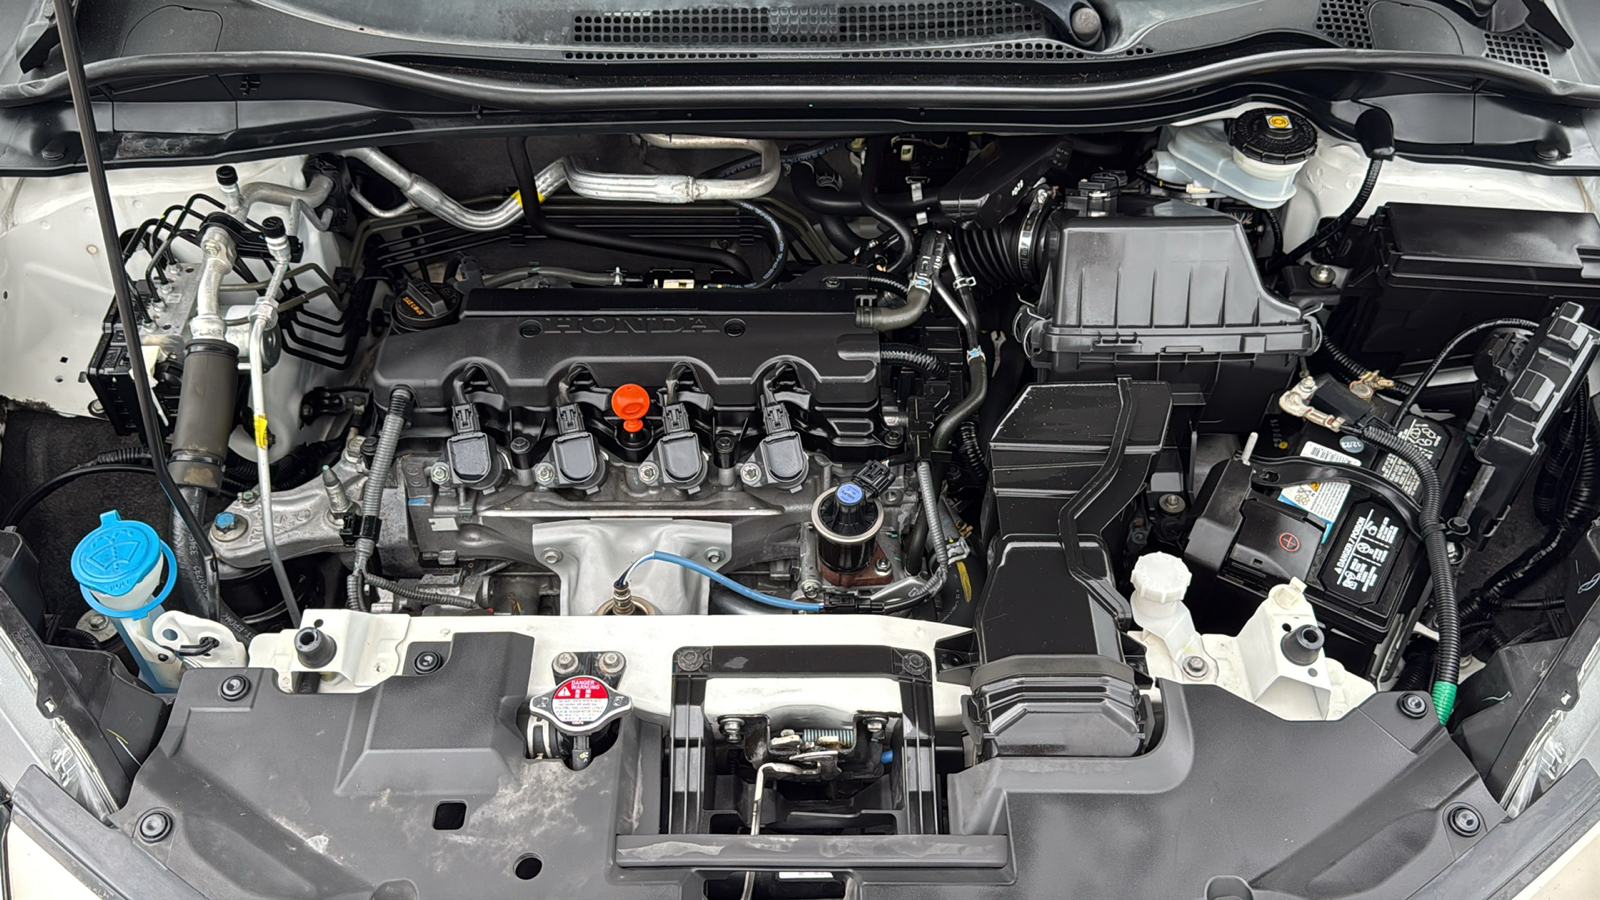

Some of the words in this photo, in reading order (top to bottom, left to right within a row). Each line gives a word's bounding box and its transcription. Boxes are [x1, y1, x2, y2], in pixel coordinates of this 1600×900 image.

[544, 318, 720, 333] HONDA
[1336, 542, 1353, 567] DANGER
[1351, 516, 1366, 540] POISON
